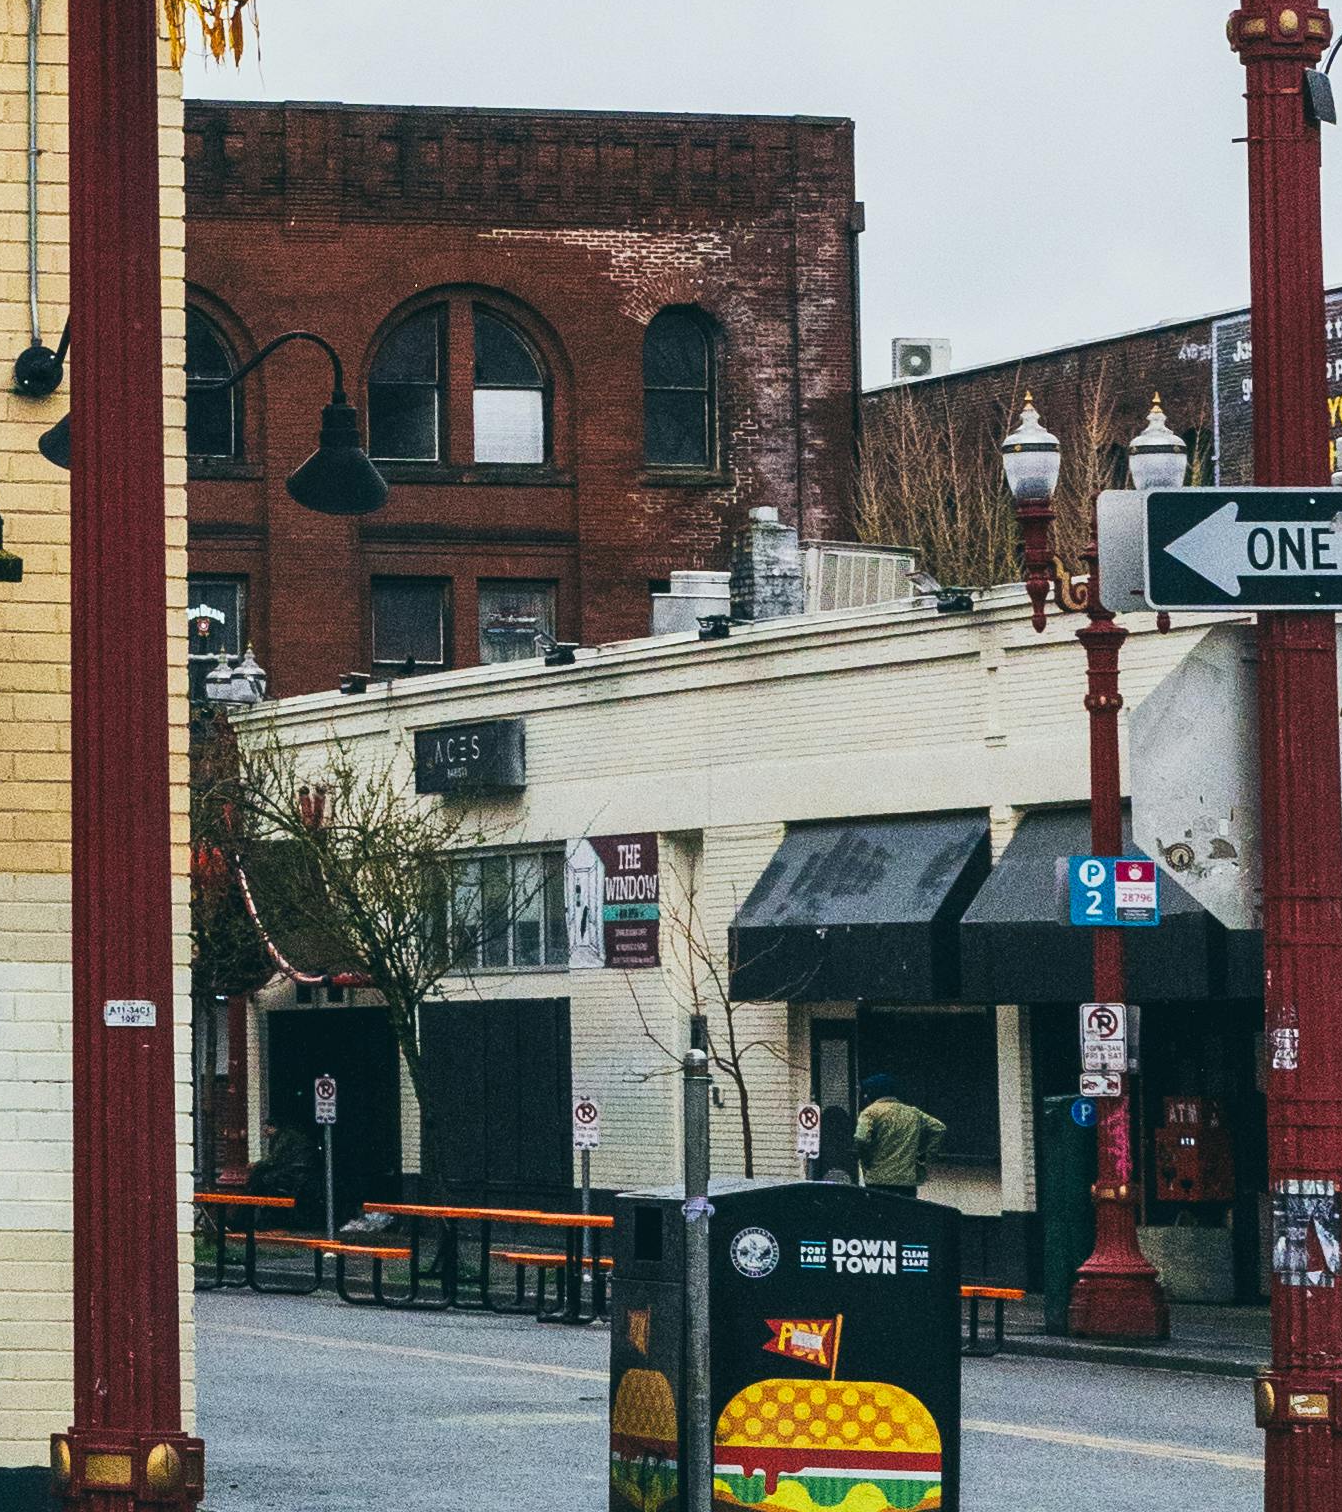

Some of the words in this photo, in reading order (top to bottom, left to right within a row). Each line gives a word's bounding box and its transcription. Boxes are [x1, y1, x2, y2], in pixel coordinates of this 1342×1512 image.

[1247, 527, 1338, 571] ONE
[435, 735, 480, 764] ACES
[617, 844, 642, 870] THE
[605, 875, 658, 901] WINDOW
[1122, 893, 1153, 902] 28796
[1085, 890, 1103, 915] 2
[800, 1246, 827, 1255] PORT
[832, 1238, 897, 1257] DOWN
[901, 1250, 929, 1258] CLEAN
[800, 1254, 827, 1263] LAND
[832, 1256, 897, 1275] TOWN
